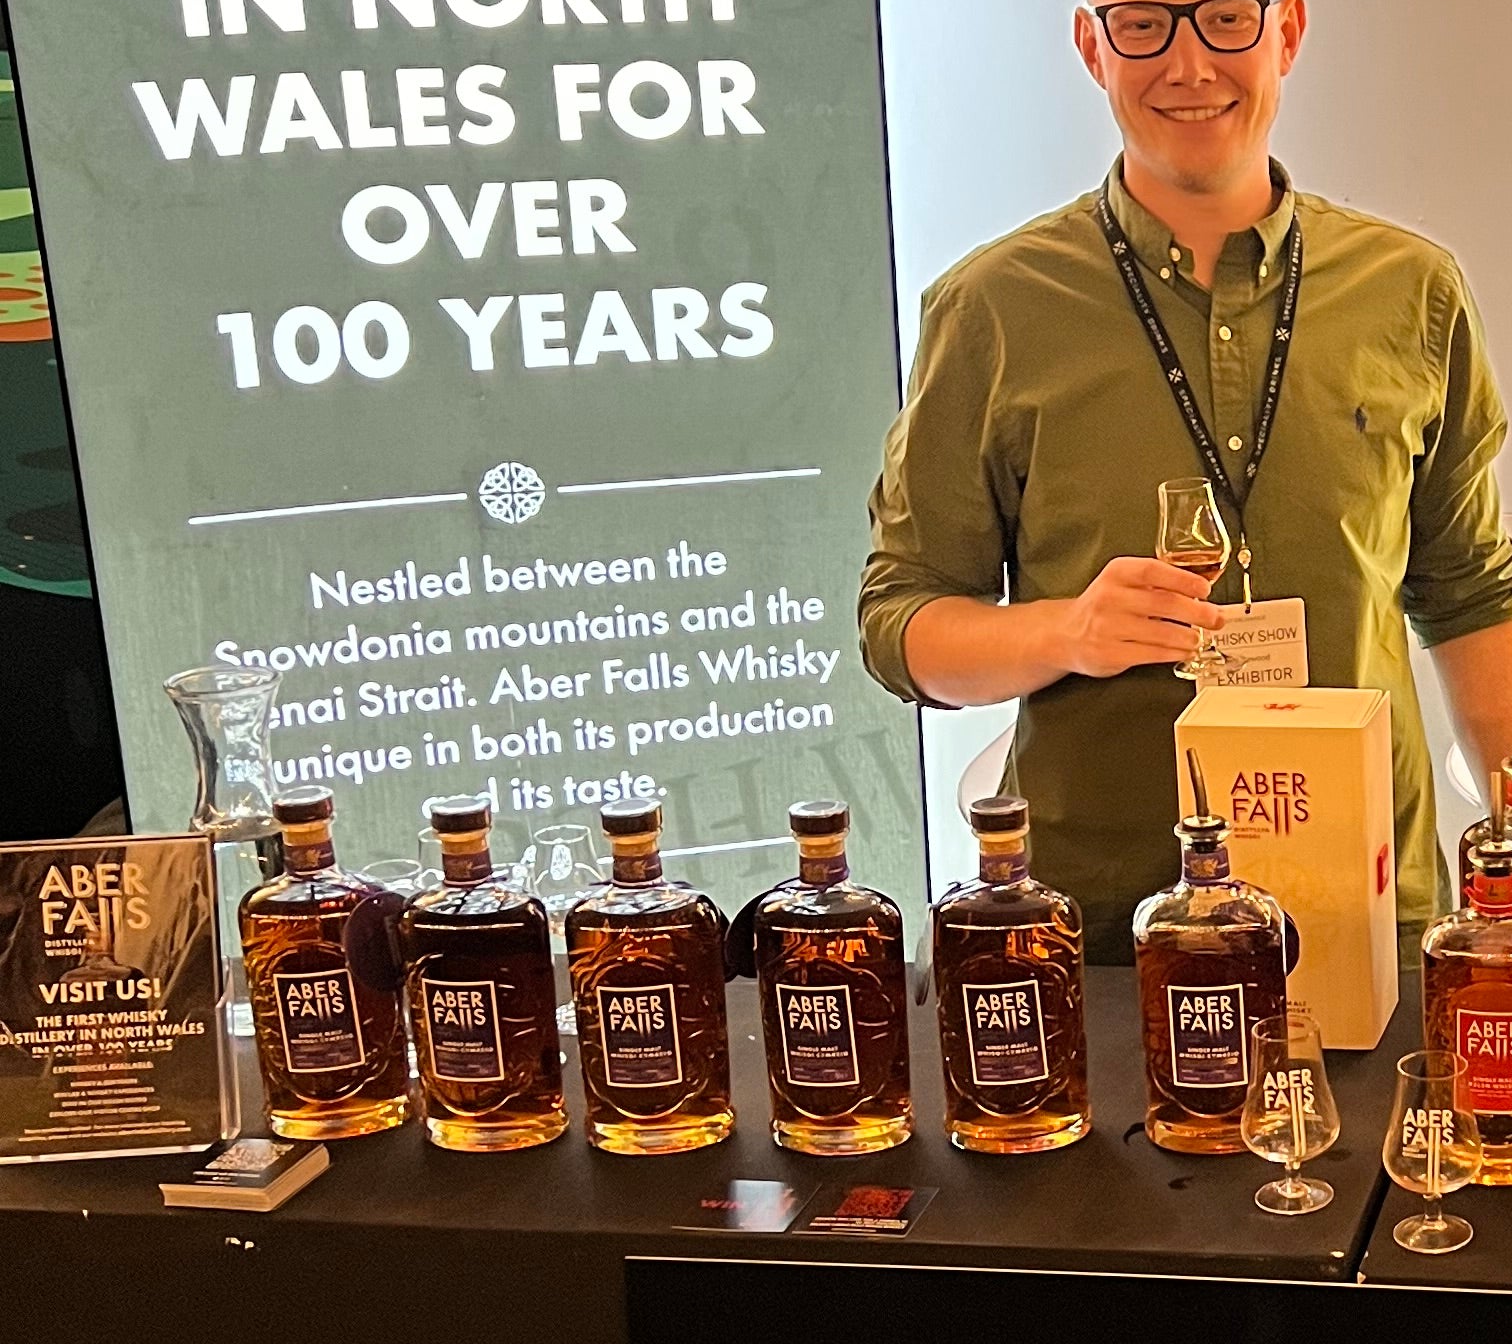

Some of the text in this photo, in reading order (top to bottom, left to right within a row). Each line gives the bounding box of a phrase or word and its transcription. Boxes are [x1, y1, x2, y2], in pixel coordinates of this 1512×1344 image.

[132, 60, 766, 160] WALES FOR
[341, 179, 637, 265] OVER
[1121, 261, 1150, 314] SPECIALITY
[1283, 265, 1298, 321] SPECIALITY
[217, 283, 774, 389] 100 YEARS
[1178, 388, 1209, 446] SPECIALITY
[1255, 397, 1274, 455] SPECIALITY
[309, 540, 727, 610] Nestled between the
[215, 588, 825, 670] Snowdonia mountains and the
[1257, 626, 1297, 643] SHOW
[269, 641, 841, 729] enai Strait. Aber Falls Whisky
[1217, 667, 1293, 686] EXHIBITOR
[274, 744, 412, 784] unique
[423, 732, 461, 766] in
[472, 718, 562, 761] both
[574, 718, 616, 751] its
[627, 698, 833, 756] production
[510, 777, 554, 811] its
[563, 770, 668, 805] taste.
[1231, 771, 1311, 797] ABER
[39, 862, 150, 899] ABER
[39, 978, 161, 1004] VISIT US!
[286, 980, 344, 1000] ABER
[432, 990, 484, 1008] ABER
[975, 991, 1030, 1011] ABER
[608, 995, 664, 1013] ABER
[787, 995, 840, 1012] ABER
[1178, 996, 1235, 1013] ABER
[35, 1010, 168, 1028] THE FIRST WHISKY
[0, 1022, 205, 1045] DISTILLERY IN NORTH WALES
[1263, 1068, 1314, 1089] ABER
[1402, 1107, 1454, 1128] ABER
